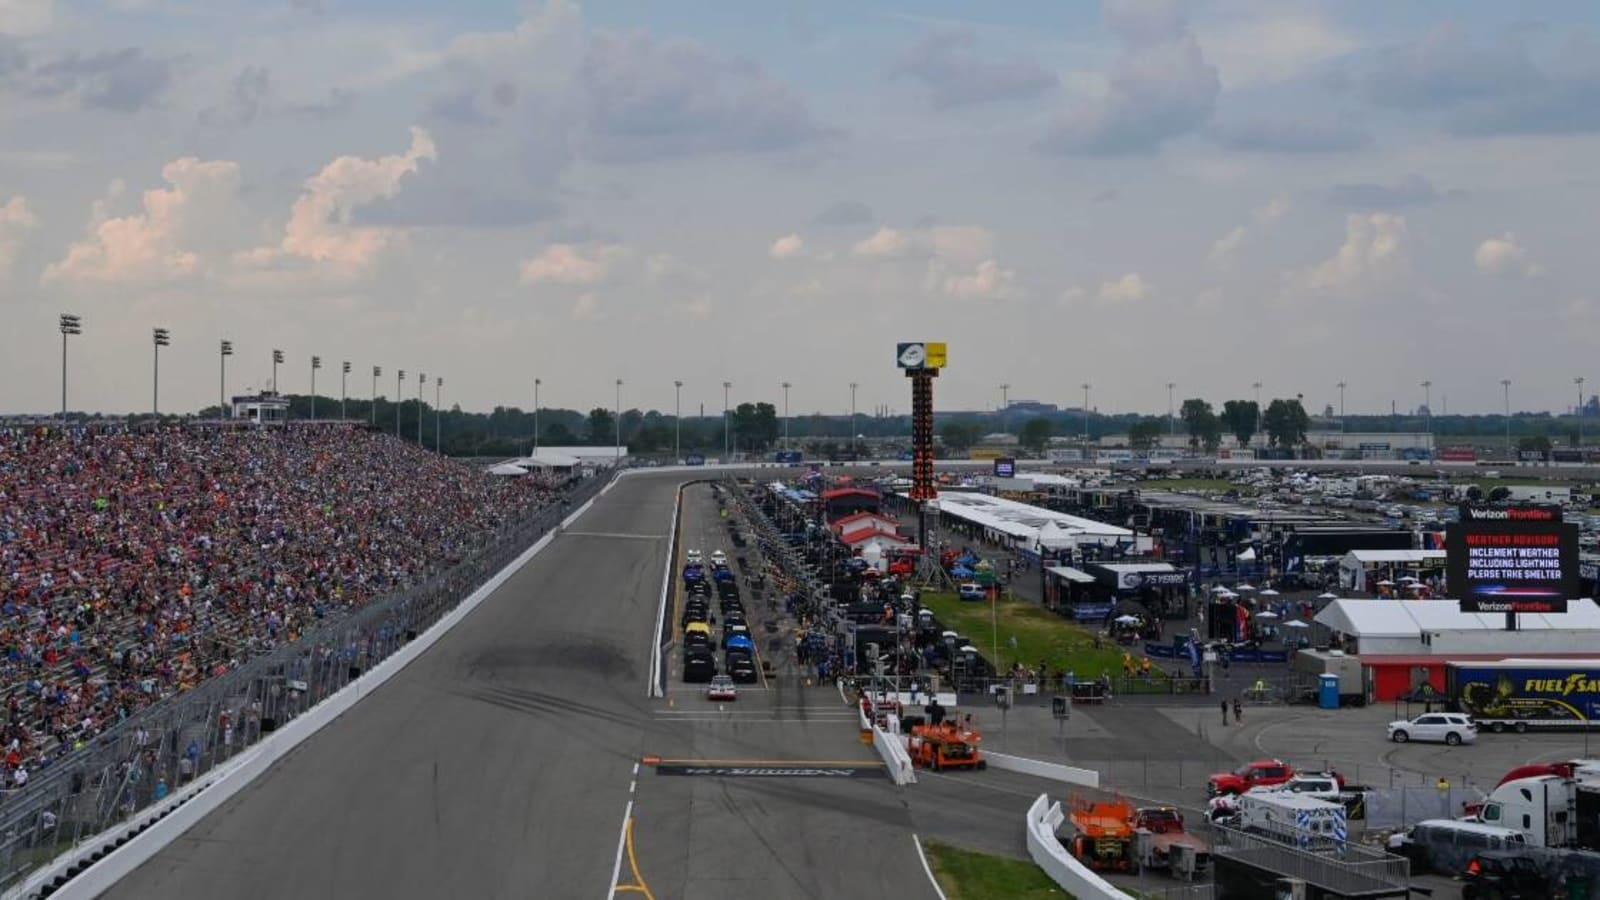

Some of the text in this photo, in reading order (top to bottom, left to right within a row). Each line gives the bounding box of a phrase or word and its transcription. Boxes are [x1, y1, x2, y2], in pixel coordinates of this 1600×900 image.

[1466, 535, 1559, 545] WEATHER ADVISORY
[1469, 548, 1560, 558] INCLEMENT WEATHER
[1469, 559, 1560, 568] INCLUDING LIGHTNING
[1468, 569, 1562, 579] PLEASE TAKE SHELTER
[1525, 679, 1600, 693] FUEL SA
